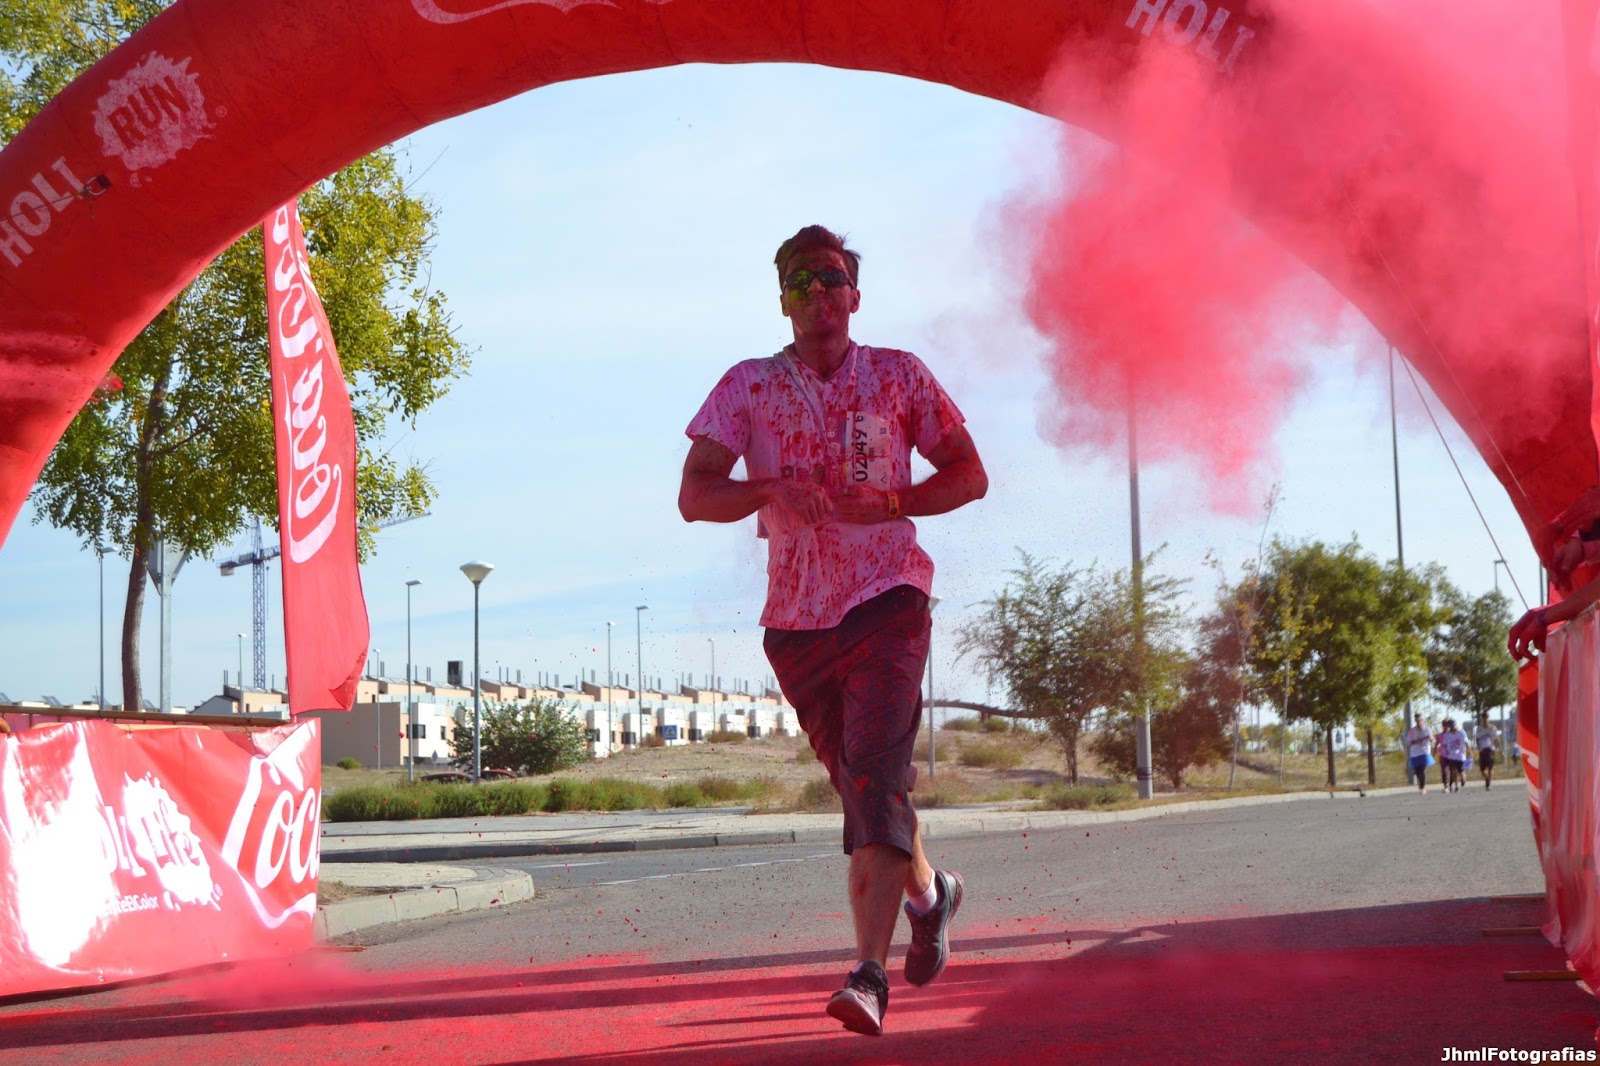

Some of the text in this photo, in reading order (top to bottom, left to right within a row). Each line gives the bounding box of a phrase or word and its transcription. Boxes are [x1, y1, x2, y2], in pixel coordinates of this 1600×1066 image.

[1125, 0, 1255, 78] HOLI
[0, 73, 193, 268] HOLI RUN
[852, 428, 869, 482] 02049
